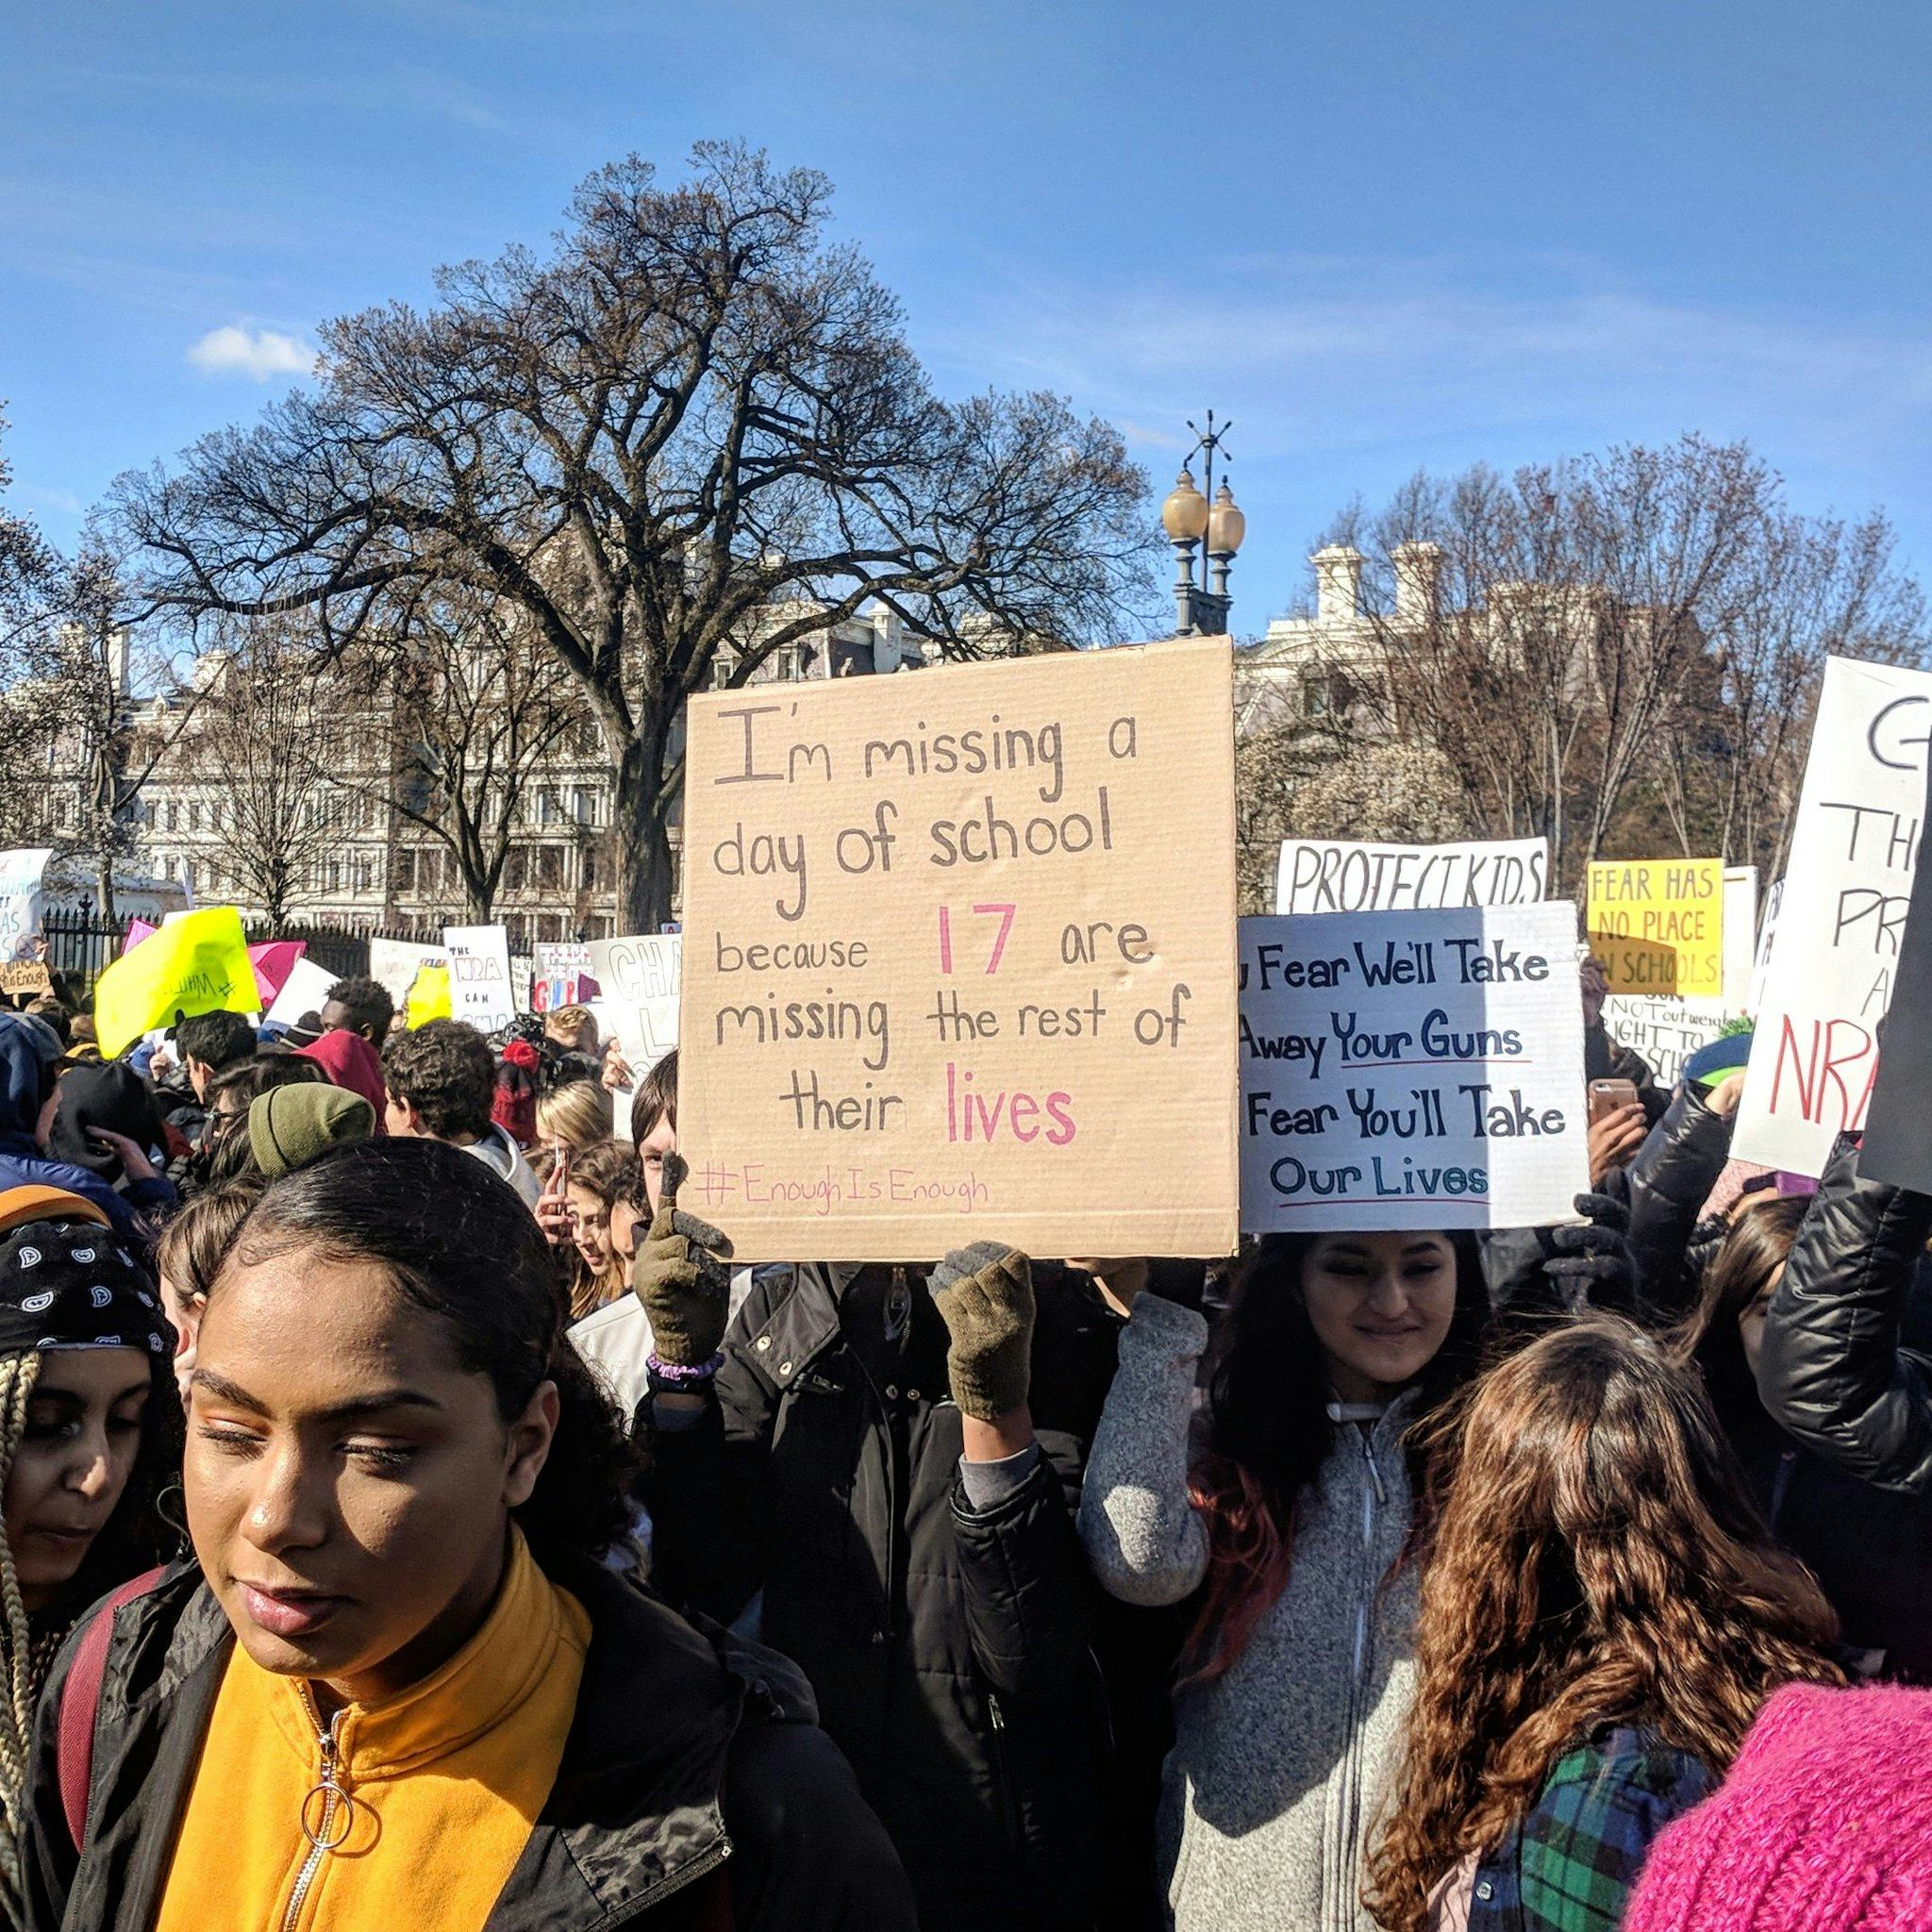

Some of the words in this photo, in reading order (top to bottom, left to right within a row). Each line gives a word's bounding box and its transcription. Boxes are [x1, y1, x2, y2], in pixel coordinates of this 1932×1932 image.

[714, 701, 832, 784] I'm
[864, 714, 1063, 803] missing
[1108, 717, 1137, 758] a
[713, 822, 808, 922] day
[836, 799, 898, 874] of
[929, 786, 1112, 867] school
[1820, 802, 1918, 872] TH
[1289, 845, 1461, 915] PROTECT
[1464, 850, 1544, 908] KIDS
[1591, 867, 1653, 902] FEAR
[1665, 867, 1714, 900] HAS
[715, 931, 869, 974] because
[939, 904, 1017, 974] 17
[1060, 921, 1156, 965] are
[1597, 911, 1630, 941] NO
[1642, 910, 1706, 941] PLACE
[1833, 888, 1911, 957] PR
[449, 947, 470, 957] THE
[455, 958, 503, 982] NRA
[1257, 944, 1351, 991] Fear
[1354, 941, 1437, 988] We'll
[1444, 938, 1550, 985] Take
[1622, 952, 1718, 984] SCHOOLS
[465, 993, 489, 1003] CAN
[1611, 997, 1666, 1021] NOT
[716, 987, 889, 1071] missing
[925, 990, 1000, 1042] the
[1019, 988, 1107, 1037] rest
[1134, 983, 1192, 1048] of
[1239, 1014, 1326, 1080] Away
[1330, 1011, 1412, 1061] Your
[1421, 1008, 1523, 1058] Guns
[1605, 1018, 1674, 1049] IGHT
[1676, 1029, 1704, 1052] TO
[779, 1068, 904, 1131] their
[946, 1062, 1076, 1145] lives
[1247, 1091, 1340, 1137] Fear
[1346, 1088, 1446, 1140] You'll
[1459, 1083, 1566, 1138] Take
[1270, 1157, 1361, 1194] Our
[1371, 1157, 1489, 1195] Lives
